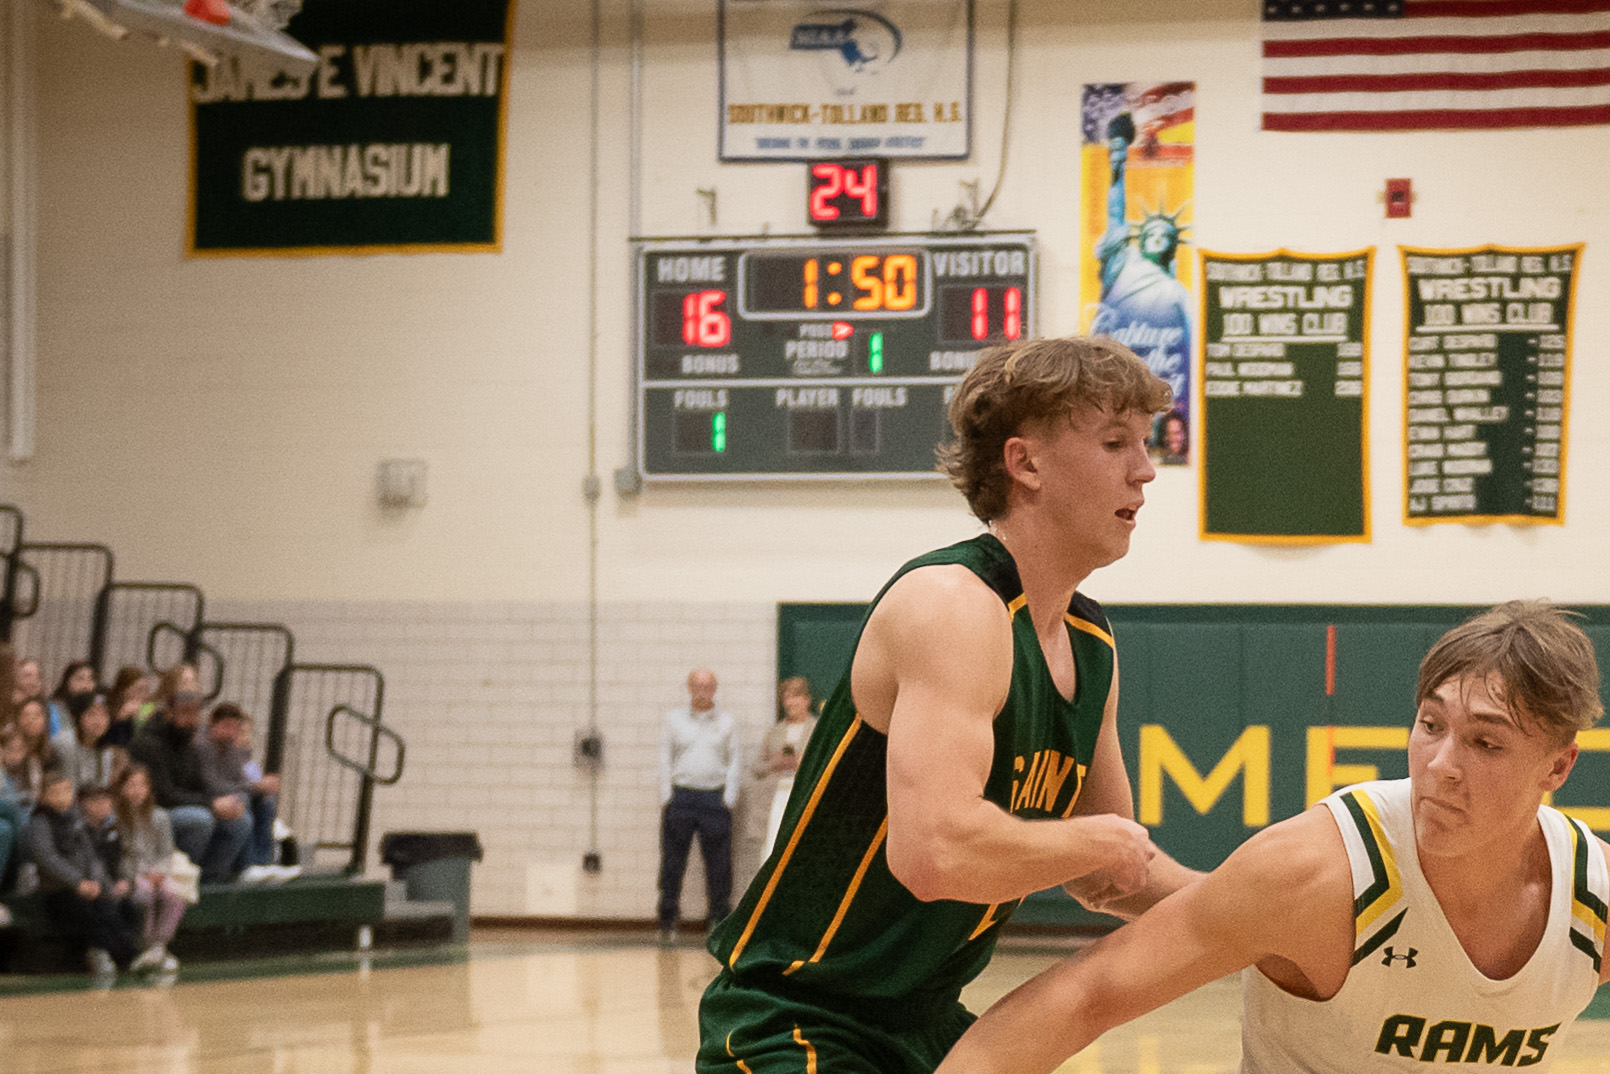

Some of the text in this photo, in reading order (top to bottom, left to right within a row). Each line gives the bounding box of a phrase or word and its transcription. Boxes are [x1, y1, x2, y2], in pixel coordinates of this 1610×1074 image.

[353, 41, 503, 97] VINCENT
[241, 143, 451, 201] GYMNASIUM
[809, 164, 878, 221] 24
[657, 256, 726, 283] HOME
[803, 253, 918, 311] 1:50
[934, 251, 1025, 277] VISITOR
[1418, 276, 1562, 301] WRESTLING
[682, 289, 732, 348] 16
[971, 286, 1022, 341] 11
[681, 353, 740, 375] BONUS
[785, 340, 849, 360] PERIOD
[868, 331, 884, 374] 1
[929, 351, 977, 371] BONU
[674, 389, 731, 409] FOULS
[776, 387, 908, 409] PLAYER FOULS
[711, 411, 727, 454] 1
[1138, 723, 1410, 828] ME
[1374, 1013, 1562, 1068] RAMS
